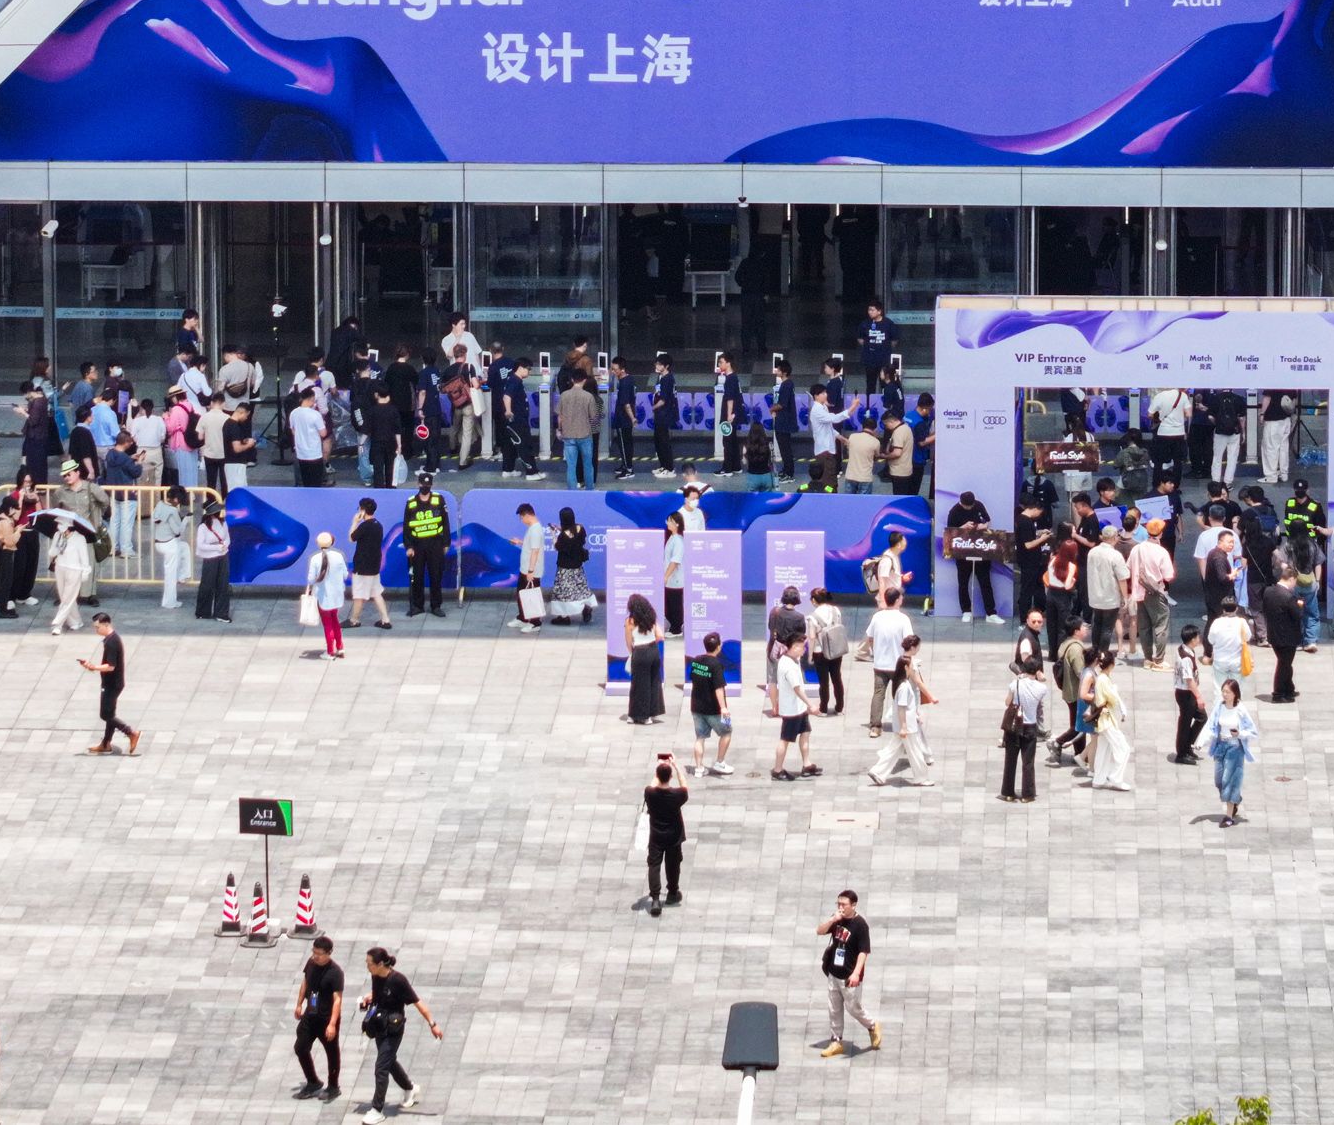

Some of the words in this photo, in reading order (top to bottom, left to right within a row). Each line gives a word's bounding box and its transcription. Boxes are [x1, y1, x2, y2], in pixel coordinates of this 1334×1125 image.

[481, 32, 693, 85] 设计上海
[1015, 353, 1035, 363] VIP
[1037, 354, 1087, 363] Entrance
[1189, 354, 1213, 362] Match
[1235, 355, 1260, 363] Media
[1280, 355, 1302, 363] Trade
[943, 409, 968, 417] design
[974, 537, 997, 552] Style
[253, 807, 273, 820] 入口
